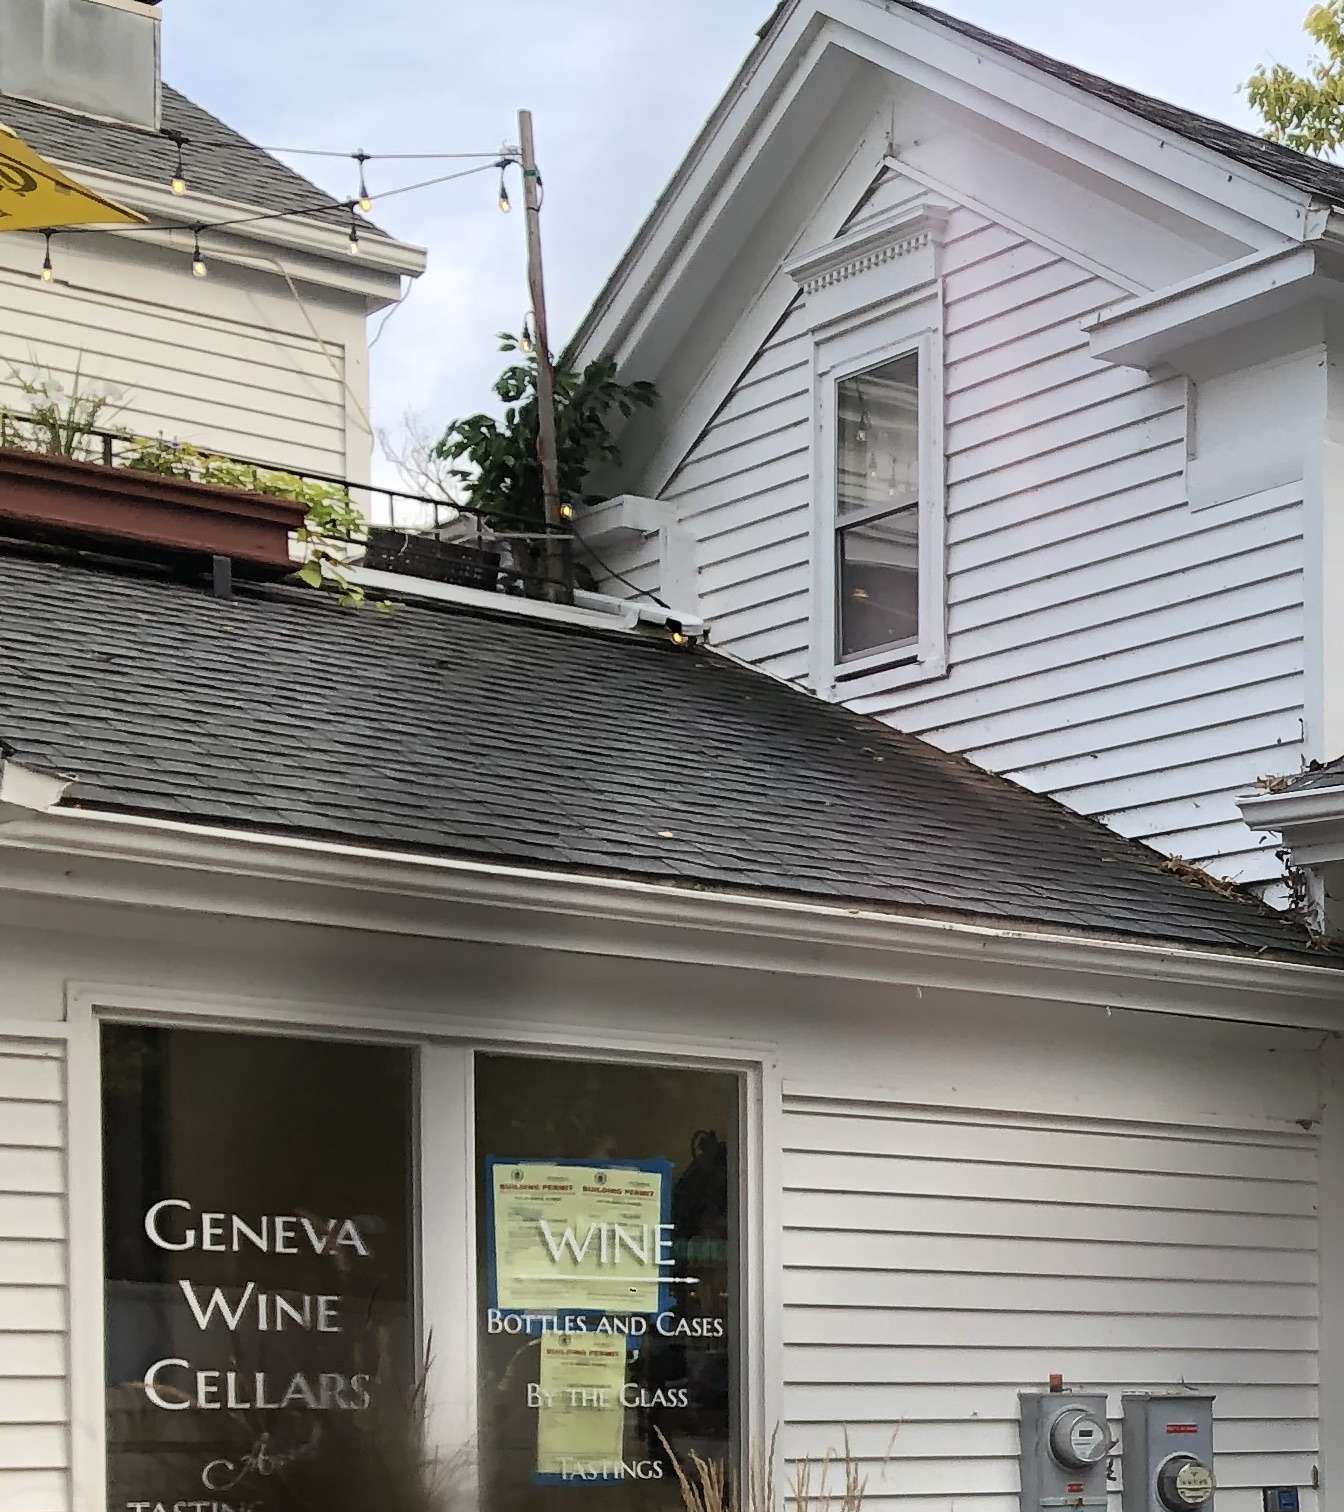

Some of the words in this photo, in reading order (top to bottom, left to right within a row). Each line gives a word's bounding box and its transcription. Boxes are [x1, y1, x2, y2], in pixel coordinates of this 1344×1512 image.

[144, 1199, 370, 1256] GENEVA
[538, 1218, 676, 1266] WINE
[178, 1279, 344, 1332] WINE
[487, 1308, 587, 1334] BOTTLES
[597, 1315, 647, 1336] AND
[656, 1311, 724, 1338] CASES
[143, 1358, 371, 1411] CELLARS
[569, 1388, 610, 1408] THE
[620, 1382, 688, 1408] GLASS
[559, 1457, 664, 1481] TASTINGS
